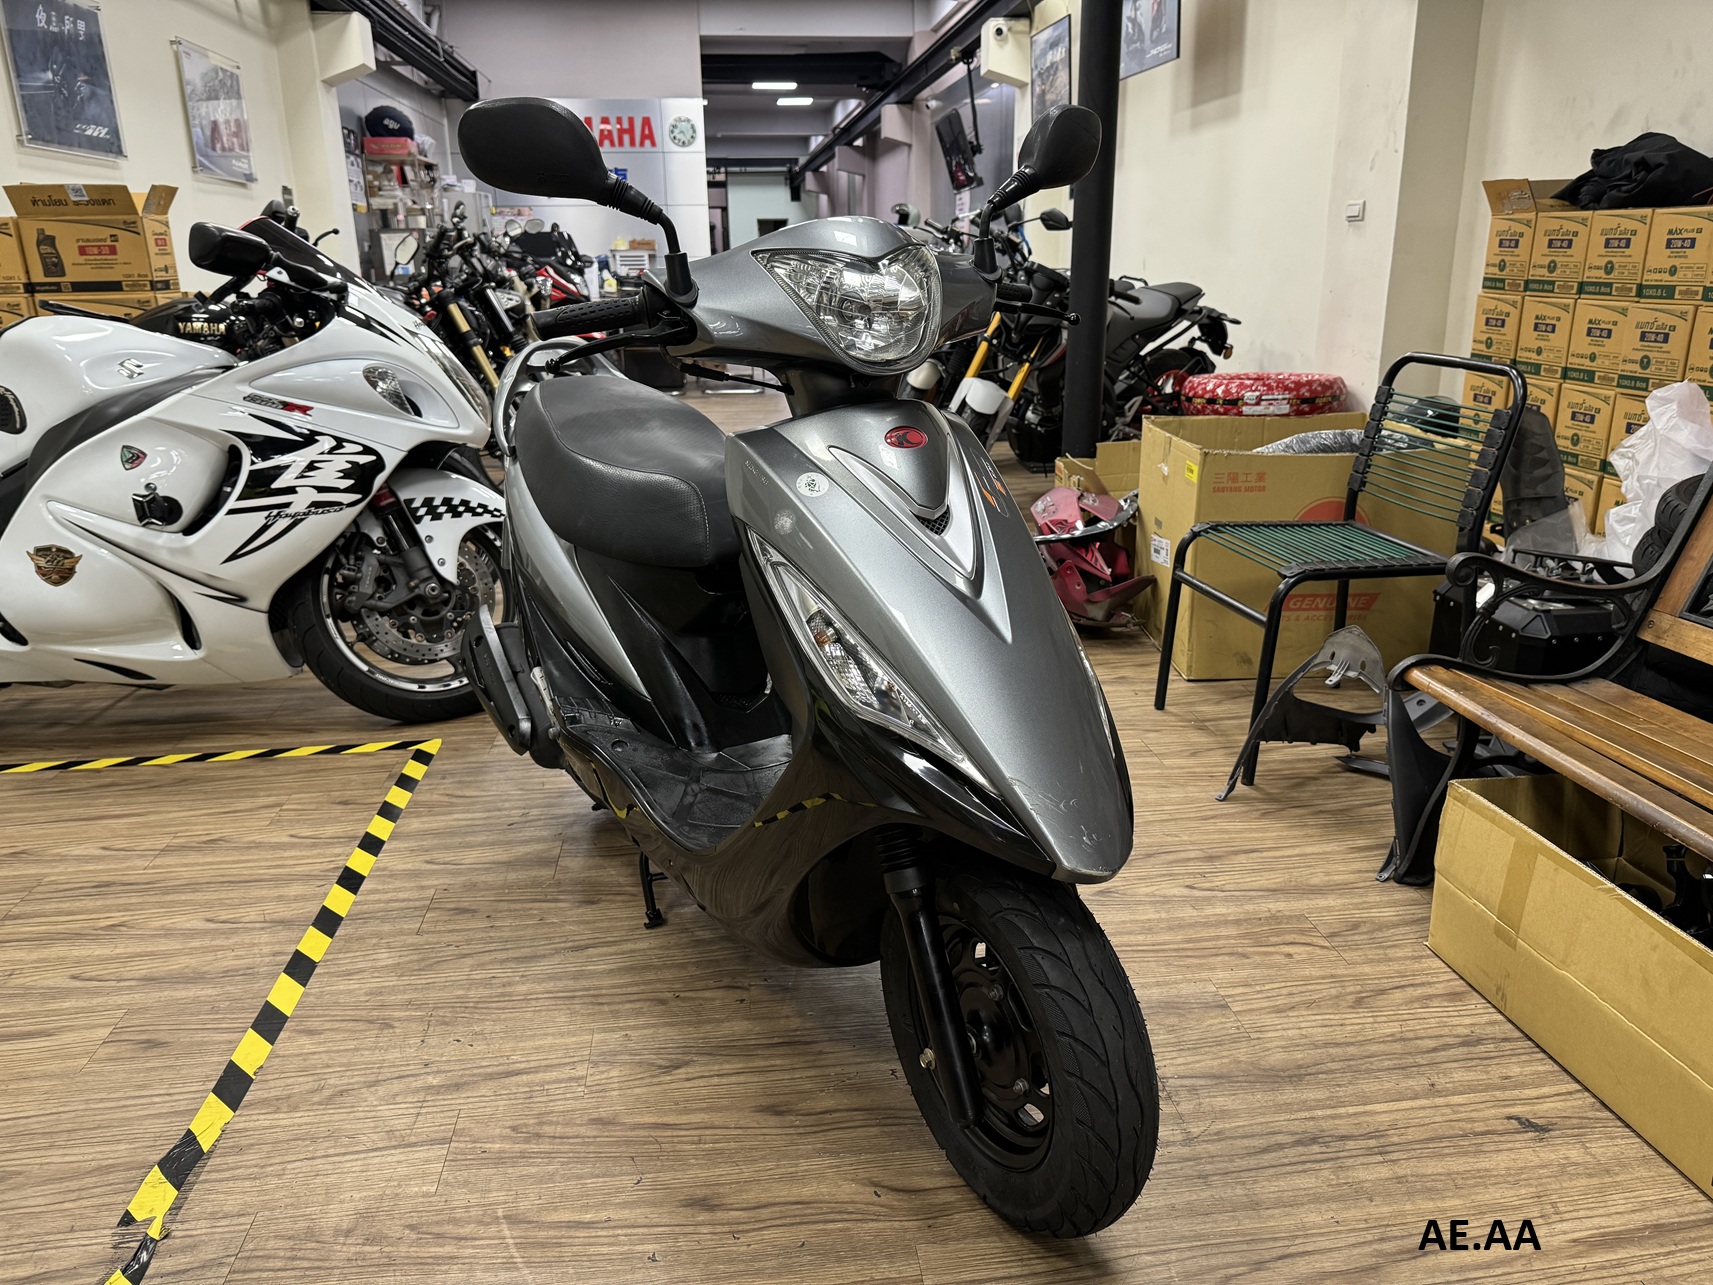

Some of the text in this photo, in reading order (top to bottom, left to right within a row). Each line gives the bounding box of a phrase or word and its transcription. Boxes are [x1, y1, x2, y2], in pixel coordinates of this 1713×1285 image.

[178, 322, 226, 334] YAMAHA
[1213, 472, 1267, 484] 三陽工業
[264, 504, 347, 522] Hayabusa
[1289, 596, 1368, 608] GENUNE
